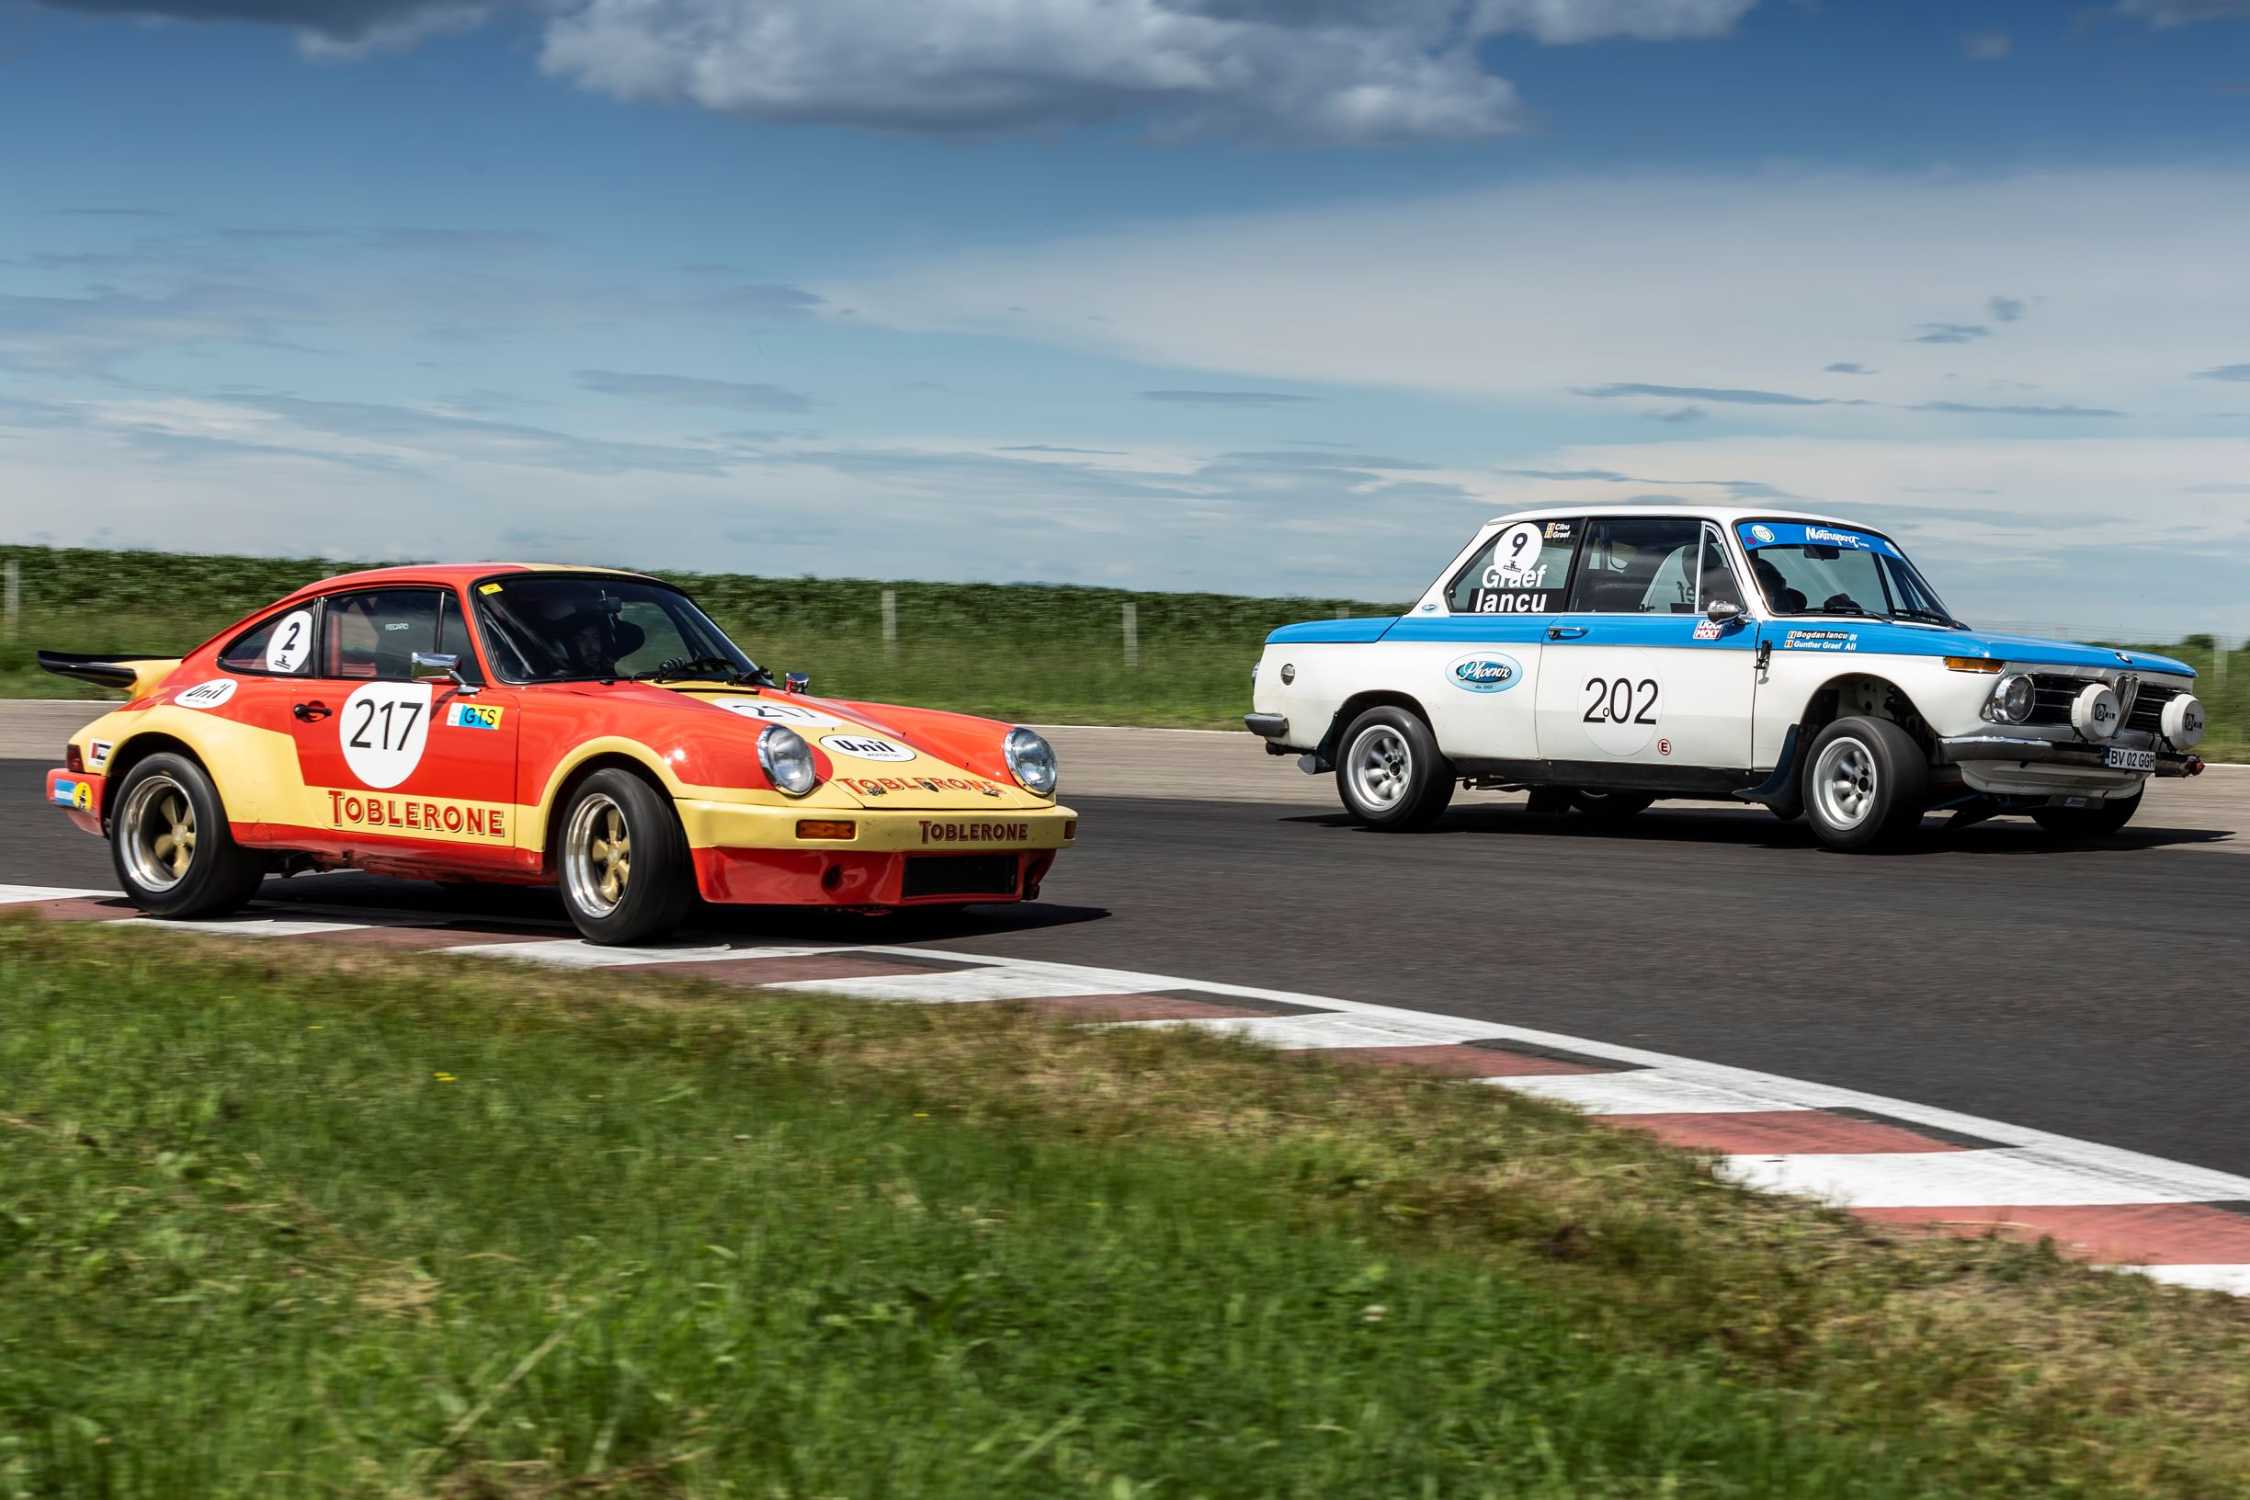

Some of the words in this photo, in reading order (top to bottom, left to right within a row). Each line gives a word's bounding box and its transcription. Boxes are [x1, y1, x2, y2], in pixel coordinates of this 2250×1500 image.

[1512, 532, 1528, 557] 9
[1482, 564, 1548, 589] Graef
[1475, 588, 1548, 613] Iancu
[281, 622, 301, 651] 2
[1796, 631, 1825, 639] Bogdan
[733, 705, 816, 718] 217
[1583, 677, 1659, 725] 202
[350, 698, 424, 752] 217
[464, 707, 497, 726] GTS
[834, 739, 896, 753] Unil
[2111, 750, 2126, 765] BV
[2127, 752, 2138, 768] 02
[328, 790, 506, 838] TOBLERONE
[919, 820, 1029, 844] TOBLERONE
